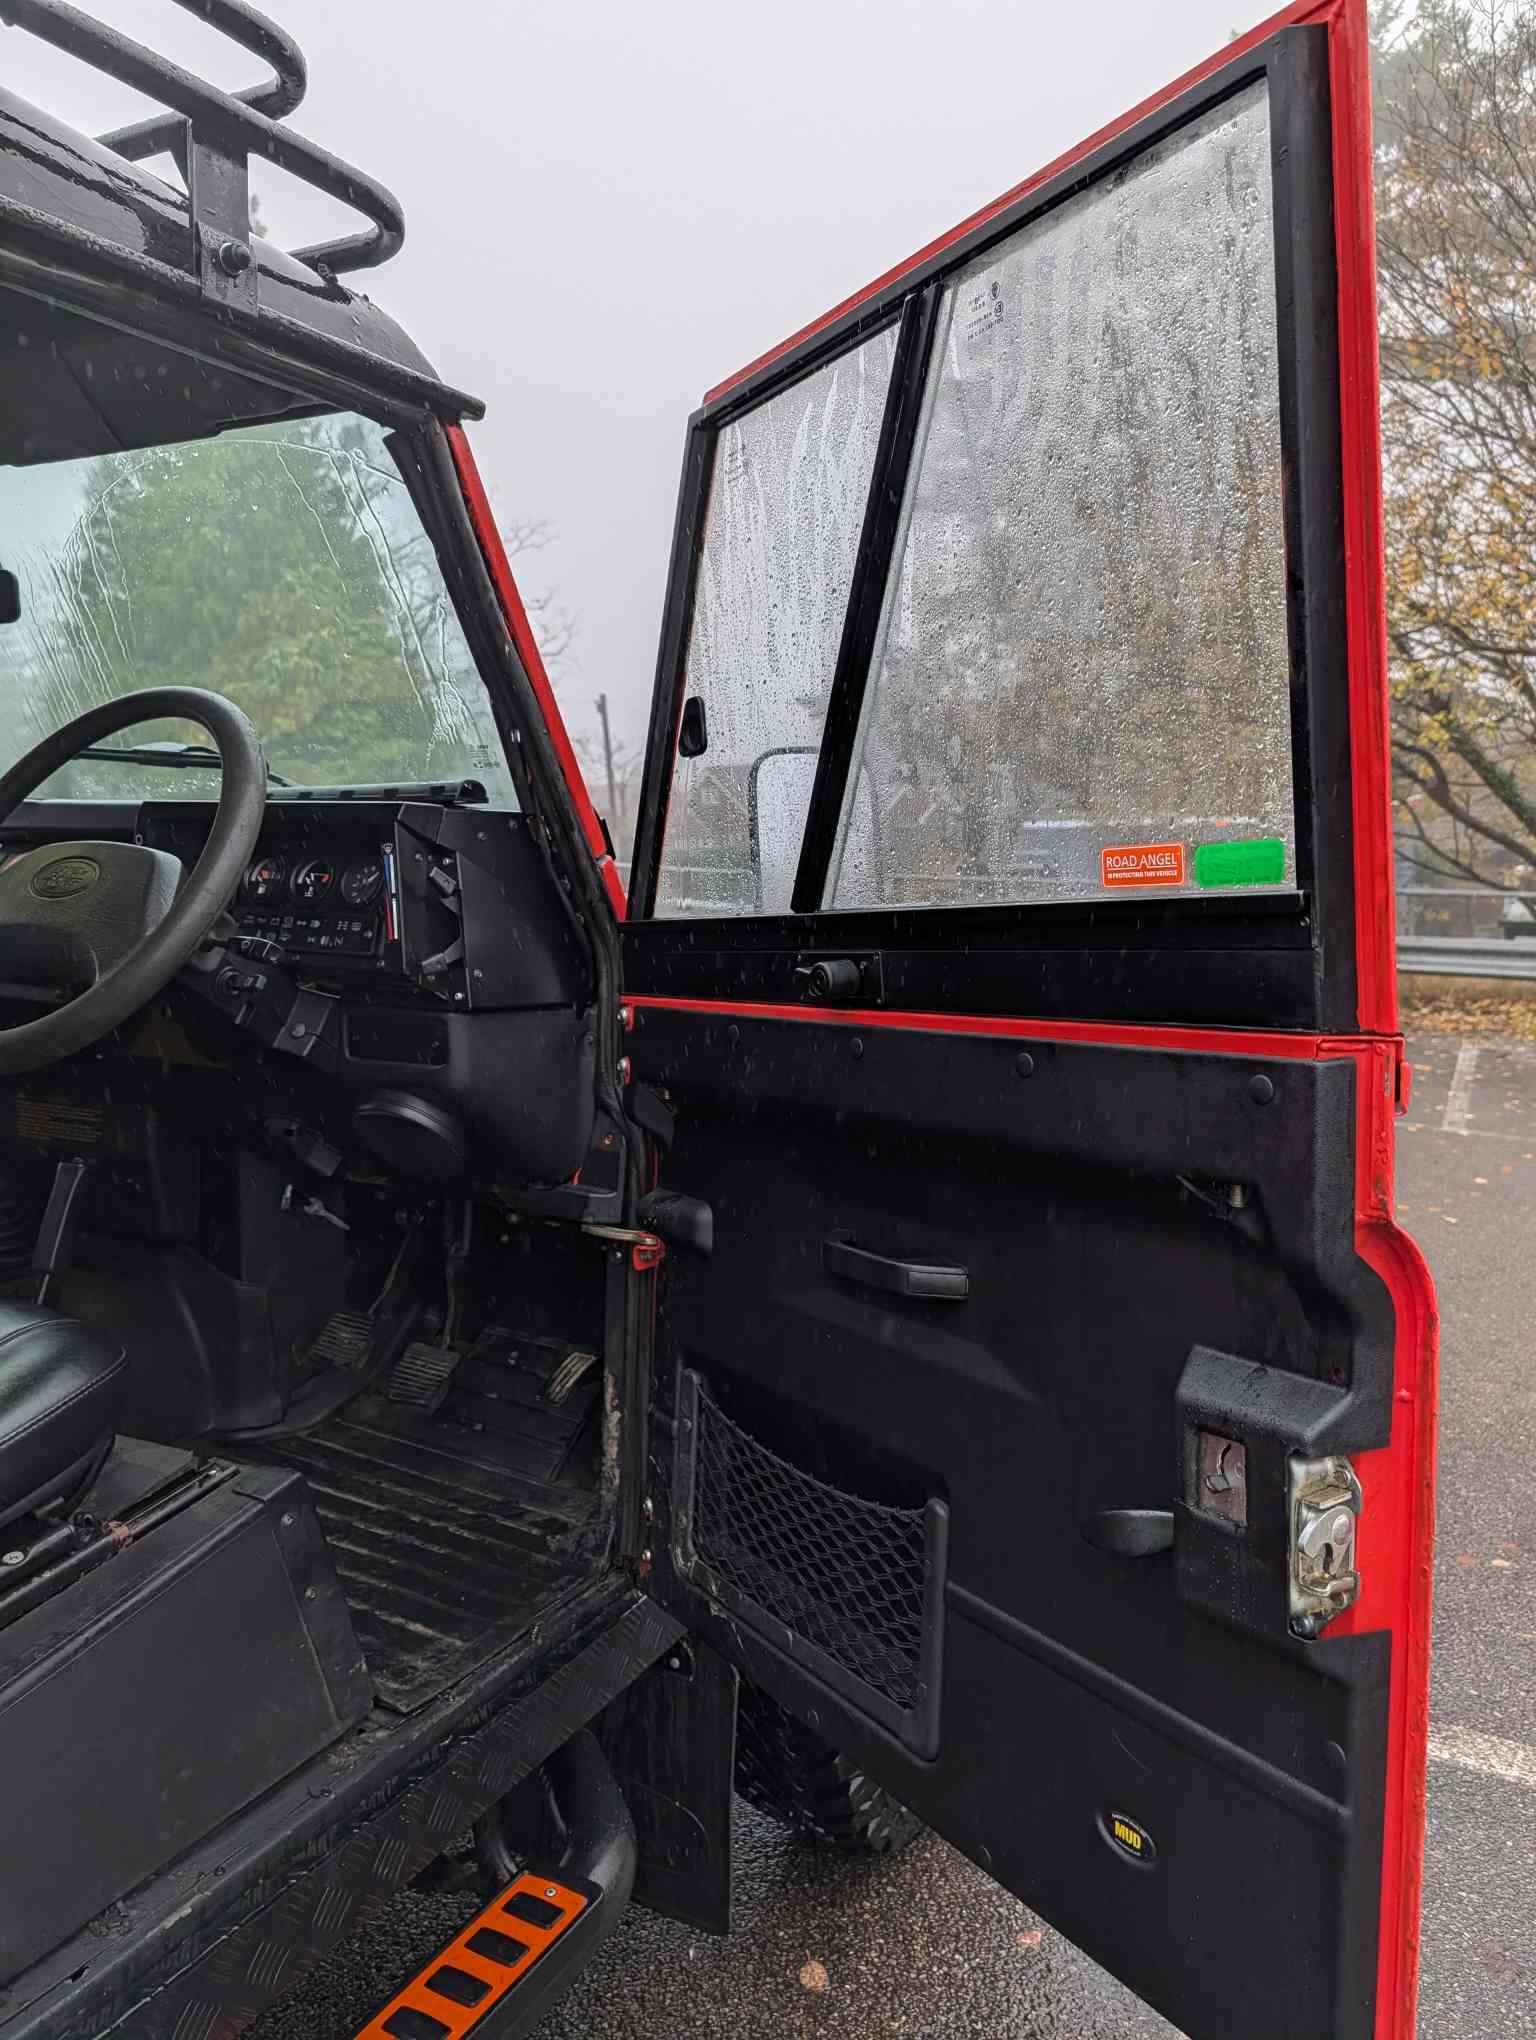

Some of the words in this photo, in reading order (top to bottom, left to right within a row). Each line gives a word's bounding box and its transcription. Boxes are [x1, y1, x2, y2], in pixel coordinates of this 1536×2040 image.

[1106, 855, 1137, 868] ROAD
[1139, 852, 1178, 866] ANGEL
[1115, 1820, 1141, 1850] MUD
